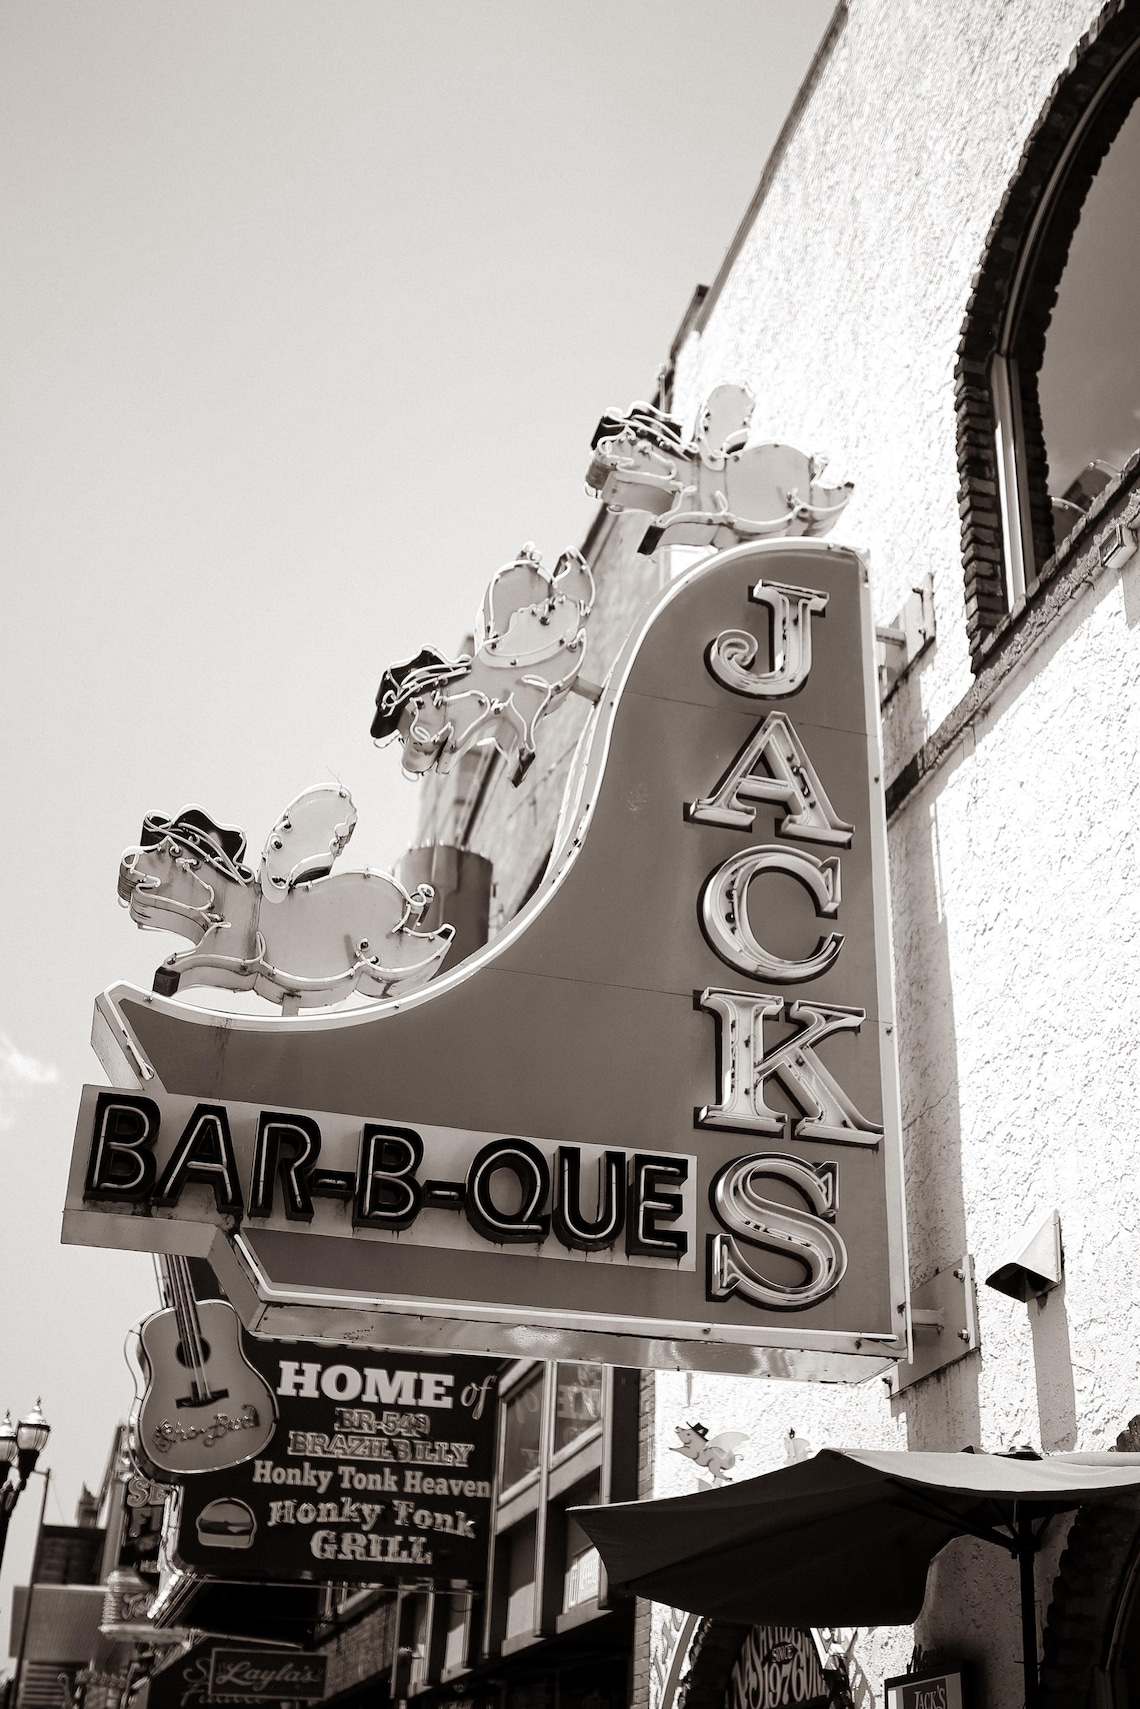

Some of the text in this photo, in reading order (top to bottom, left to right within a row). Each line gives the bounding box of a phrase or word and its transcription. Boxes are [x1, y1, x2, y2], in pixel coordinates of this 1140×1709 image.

[684, 579, 884, 1312] JACKS
[83, 1091, 690, 1261] BAR-B-QUE
[276, 1360, 497, 1420] HOME of
[334, 1407, 430, 1438] BR-549
[252, 1460, 491, 1498] Honky Tonk Heaven
[267, 1497, 476, 1539] Honky Tonk
[310, 1529, 433, 1565] GRILL
[763, 1651, 806, 1709] 1976
[913, 1684, 946, 1709] JACK'S
